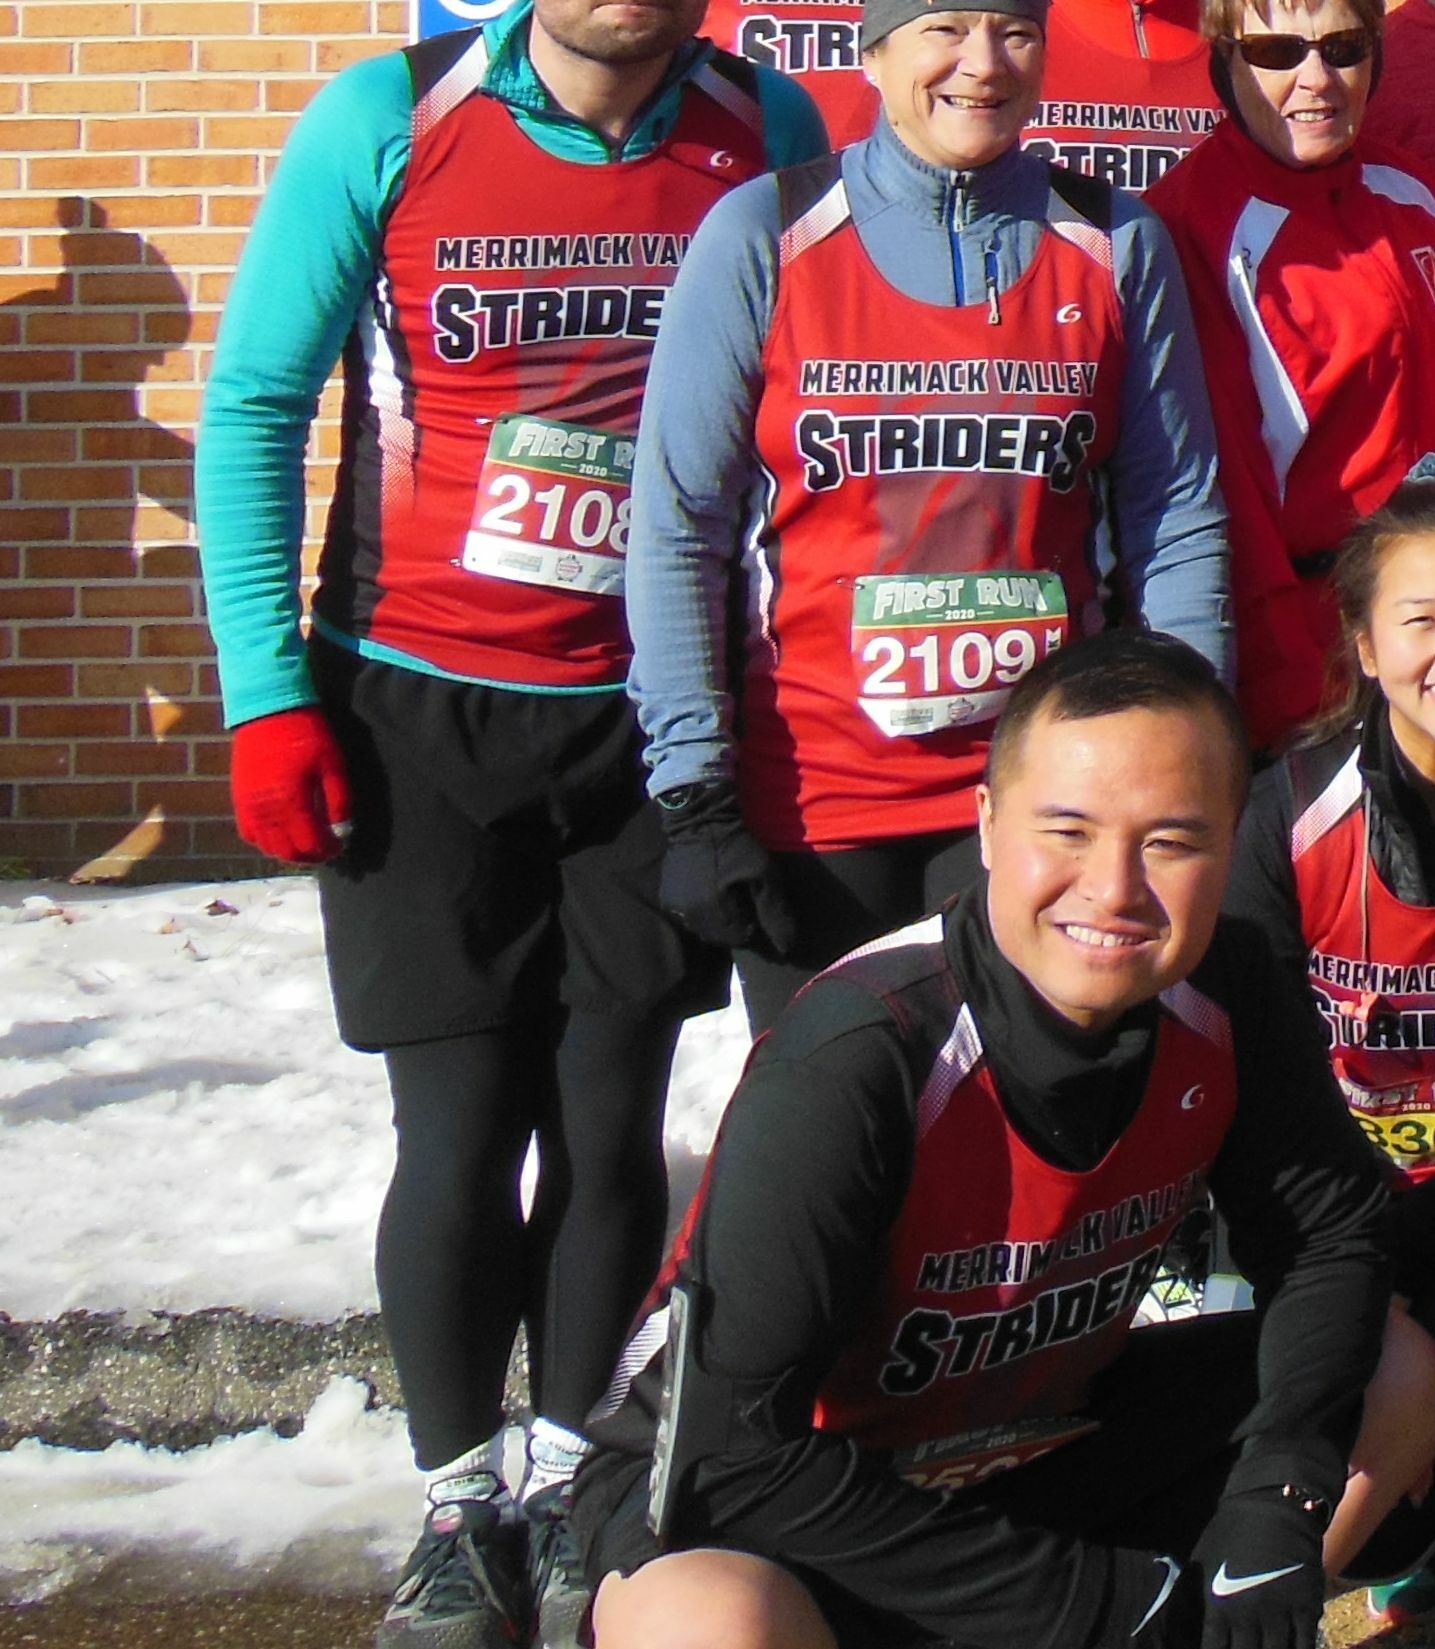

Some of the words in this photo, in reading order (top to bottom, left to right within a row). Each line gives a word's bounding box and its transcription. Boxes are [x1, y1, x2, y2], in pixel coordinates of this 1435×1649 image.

[435, 233, 635, 272] MERRIMACK
[432, 282, 661, 365] STRIDE
[800, 358, 988, 397] MERRIMACK
[994, 360, 1099, 396] VALLEY
[508, 422, 602, 460] FIRST
[795, 408, 1097, 494] STRIDERS
[579, 463, 608, 477] 2020
[872, 578, 966, 621] FIRST
[977, 576, 1048, 614] RUN
[945, 609, 976, 620] 2020
[858, 629, 1037, 695] 2109
[1402, 1102, 1432, 1111] 2020
